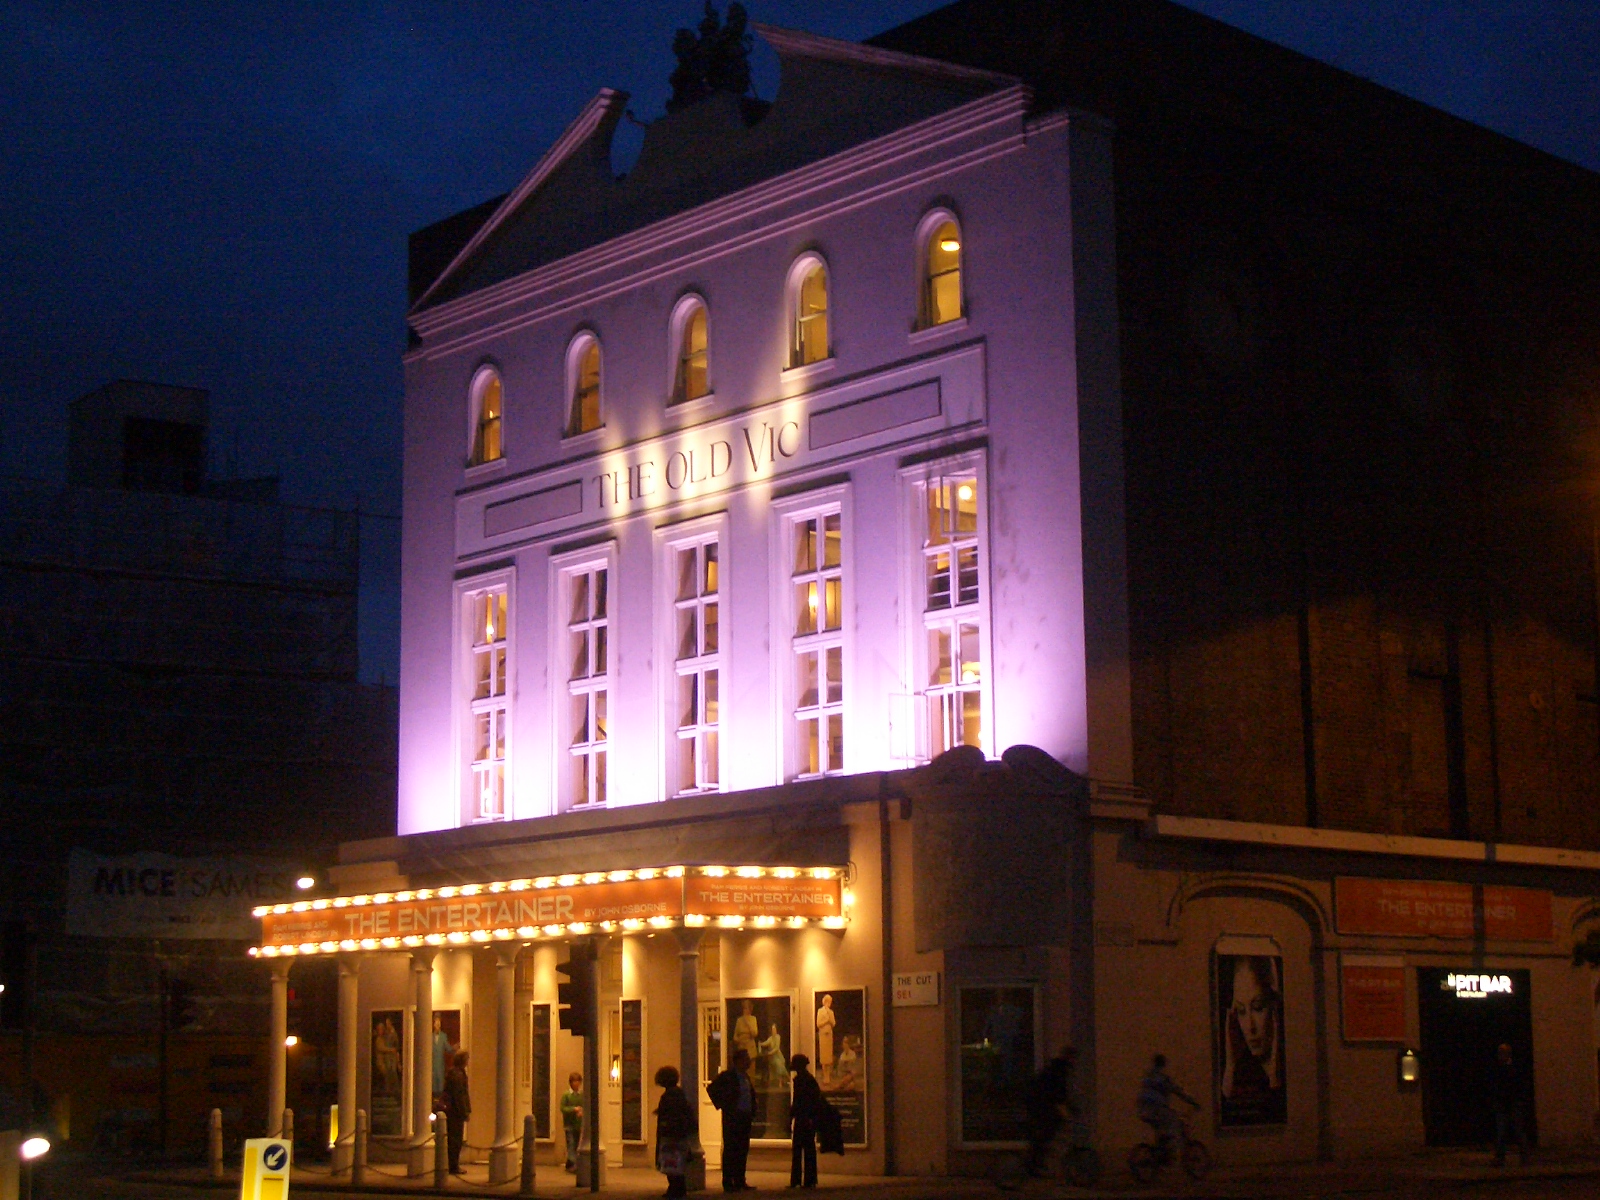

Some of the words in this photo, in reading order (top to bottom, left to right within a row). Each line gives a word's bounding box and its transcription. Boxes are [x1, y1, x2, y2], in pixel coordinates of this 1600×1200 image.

[592, 461, 655, 508] THE
[666, 440, 733, 489] OLD
[699, 891, 730, 903] THE
[734, 892, 834, 905] ENTERTAINER
[344, 910, 391, 935] THE
[398, 895, 575, 932] ENTERTAINER
[584, 908, 596, 917] BY
[598, 906, 620, 918] JOHN
[621, 902, 667, 914] OSBORNE
[1377, 899, 1410, 915] THE
[897, 977, 912, 986] THE
[916, 975, 932, 985] CUT
[1480, 974, 1512, 993] BAR
